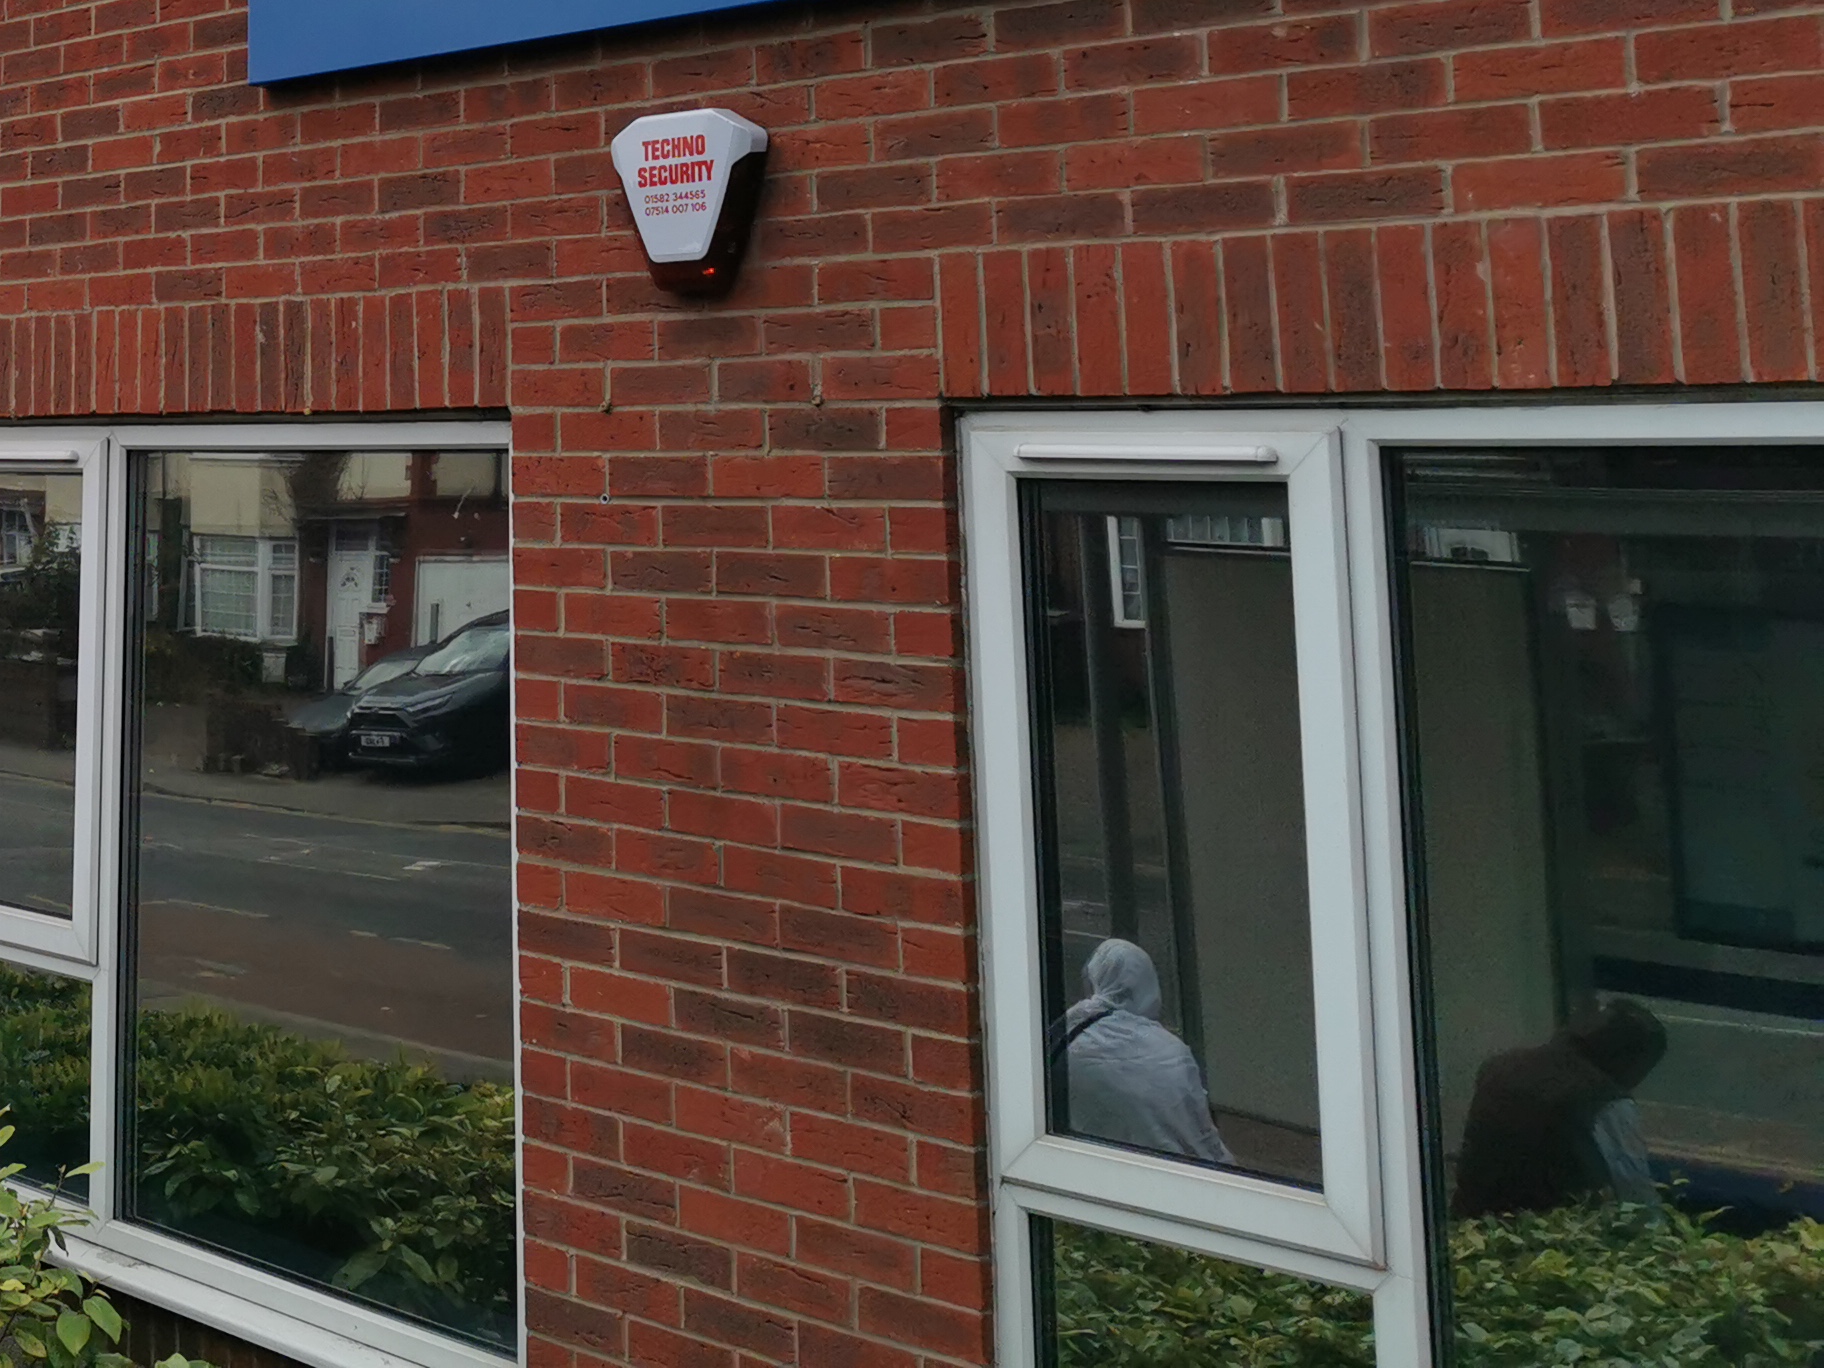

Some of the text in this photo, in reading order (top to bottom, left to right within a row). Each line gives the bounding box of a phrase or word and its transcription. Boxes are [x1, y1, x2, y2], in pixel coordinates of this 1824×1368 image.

[642, 134, 706, 162] TECHNO
[637, 159, 715, 189] SECURITY
[644, 192, 670, 205] 01582
[644, 201, 708, 217] 07514 007 106
